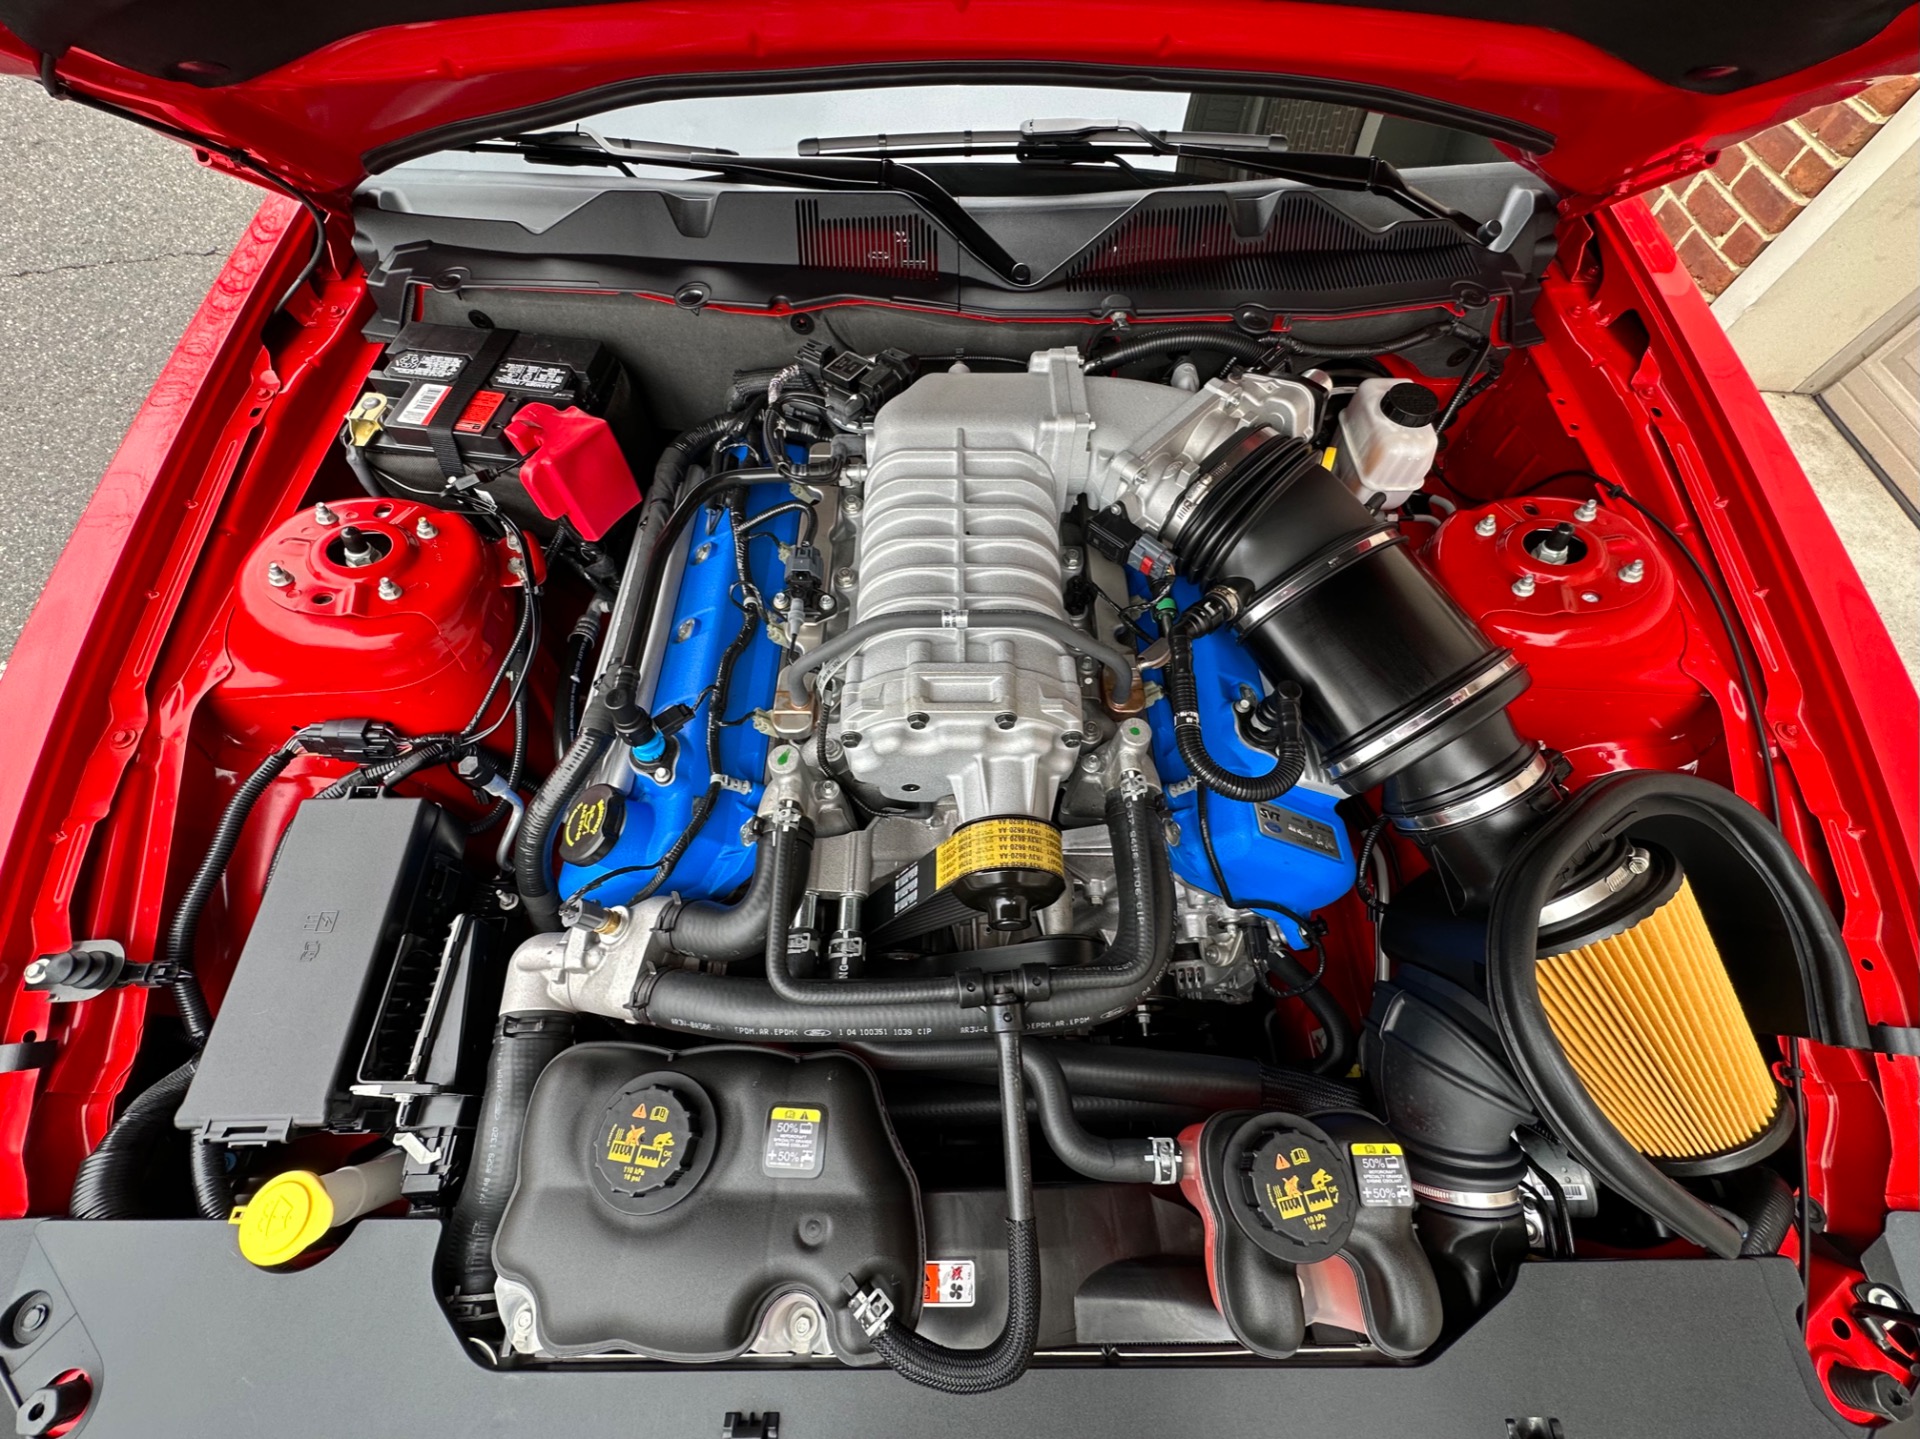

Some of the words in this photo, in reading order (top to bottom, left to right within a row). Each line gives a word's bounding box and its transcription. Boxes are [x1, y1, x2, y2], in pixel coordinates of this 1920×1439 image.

[1260, 807, 1281, 822] SVT
[776, 1122, 799, 1133] 50%
[1362, 1158, 1386, 1168] 50%
